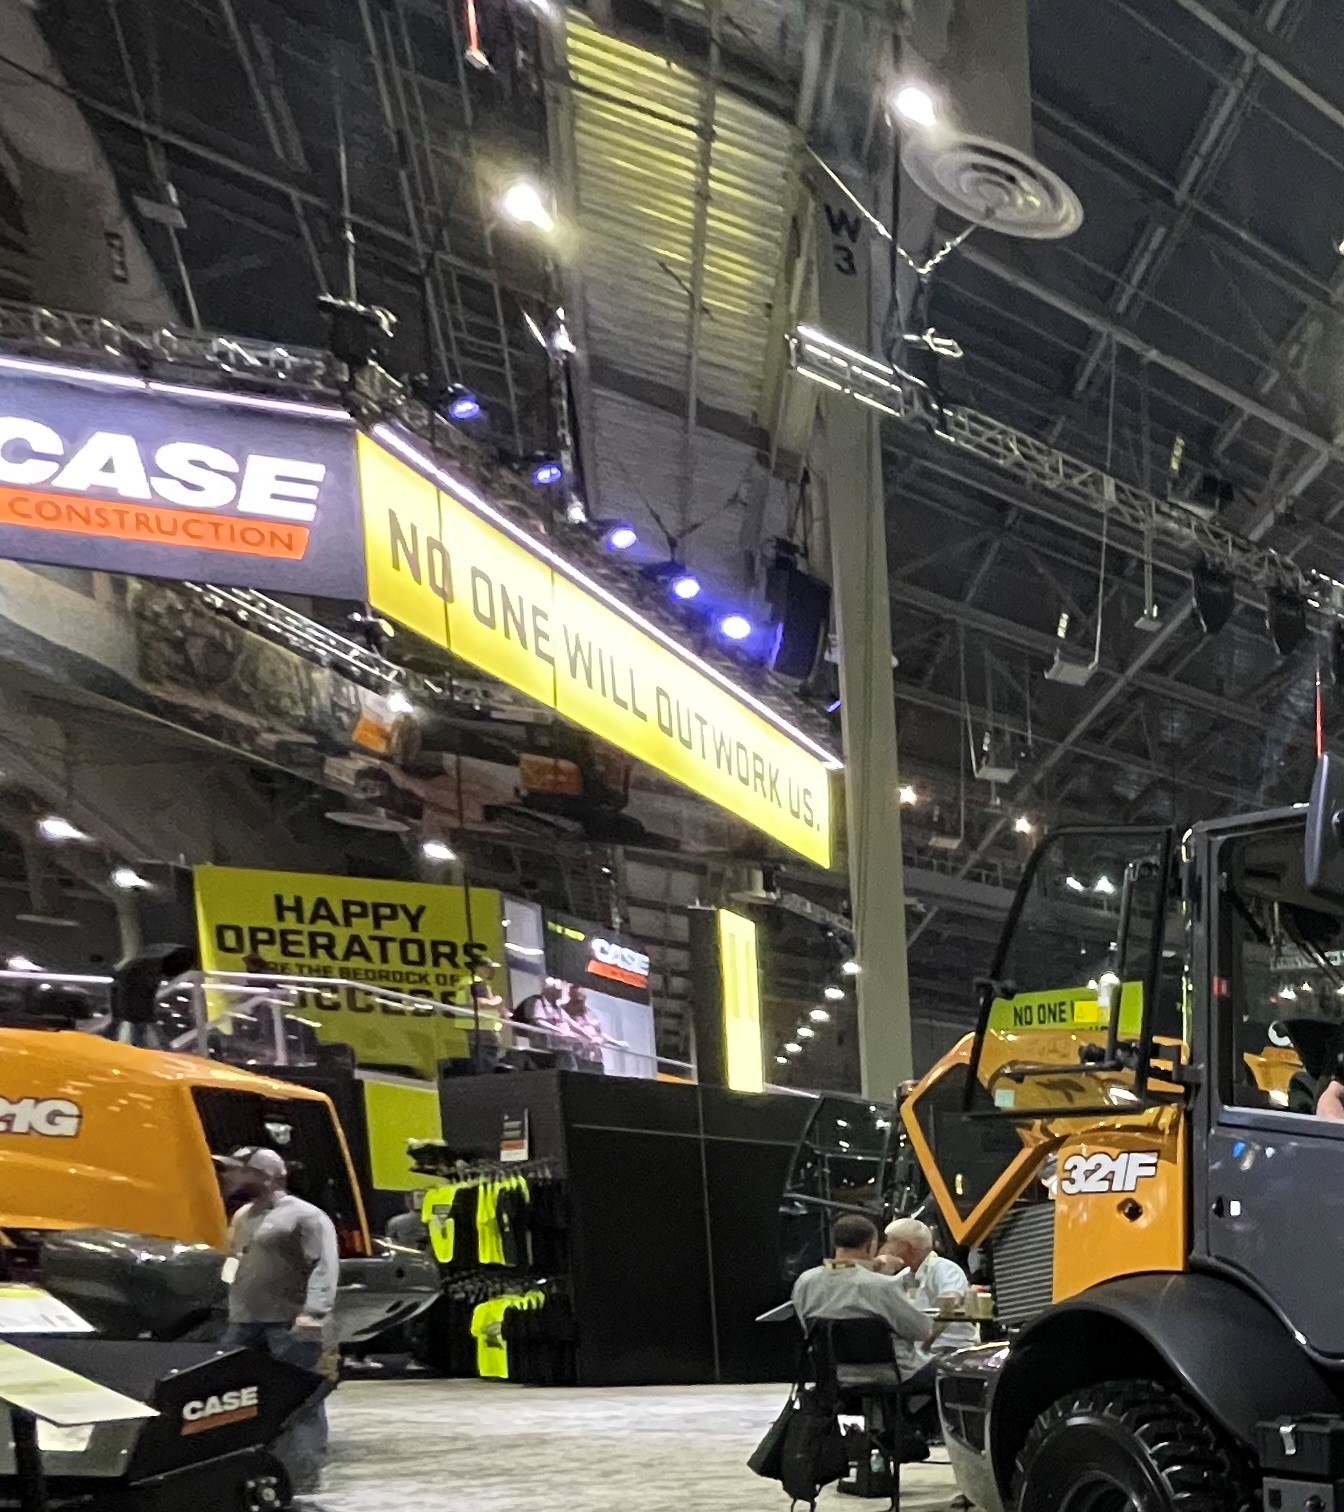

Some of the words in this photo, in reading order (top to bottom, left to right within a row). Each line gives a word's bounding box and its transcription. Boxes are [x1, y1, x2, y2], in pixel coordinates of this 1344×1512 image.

[823, 203, 861, 243] W
[833, 243, 858, 275] 3
[0, 416, 327, 522] CASE
[8, 496, 293, 552] CONSTRUCTION
[388, 508, 454, 604] NO
[471, 566, 557, 667] ONE
[563, 624, 648, 722] WILL
[656, 685, 782, 809] OUTWORK
[788, 777, 820, 832] US.
[274, 893, 427, 933] HAPPY
[215, 924, 488, 972] OPERATORS
[1013, 1005, 1033, 1026] NO
[1037, 1001, 1067, 1024] ONE
[1061, 1151, 1159, 1195] 321F
[182, 1386, 259, 1421] CASE
